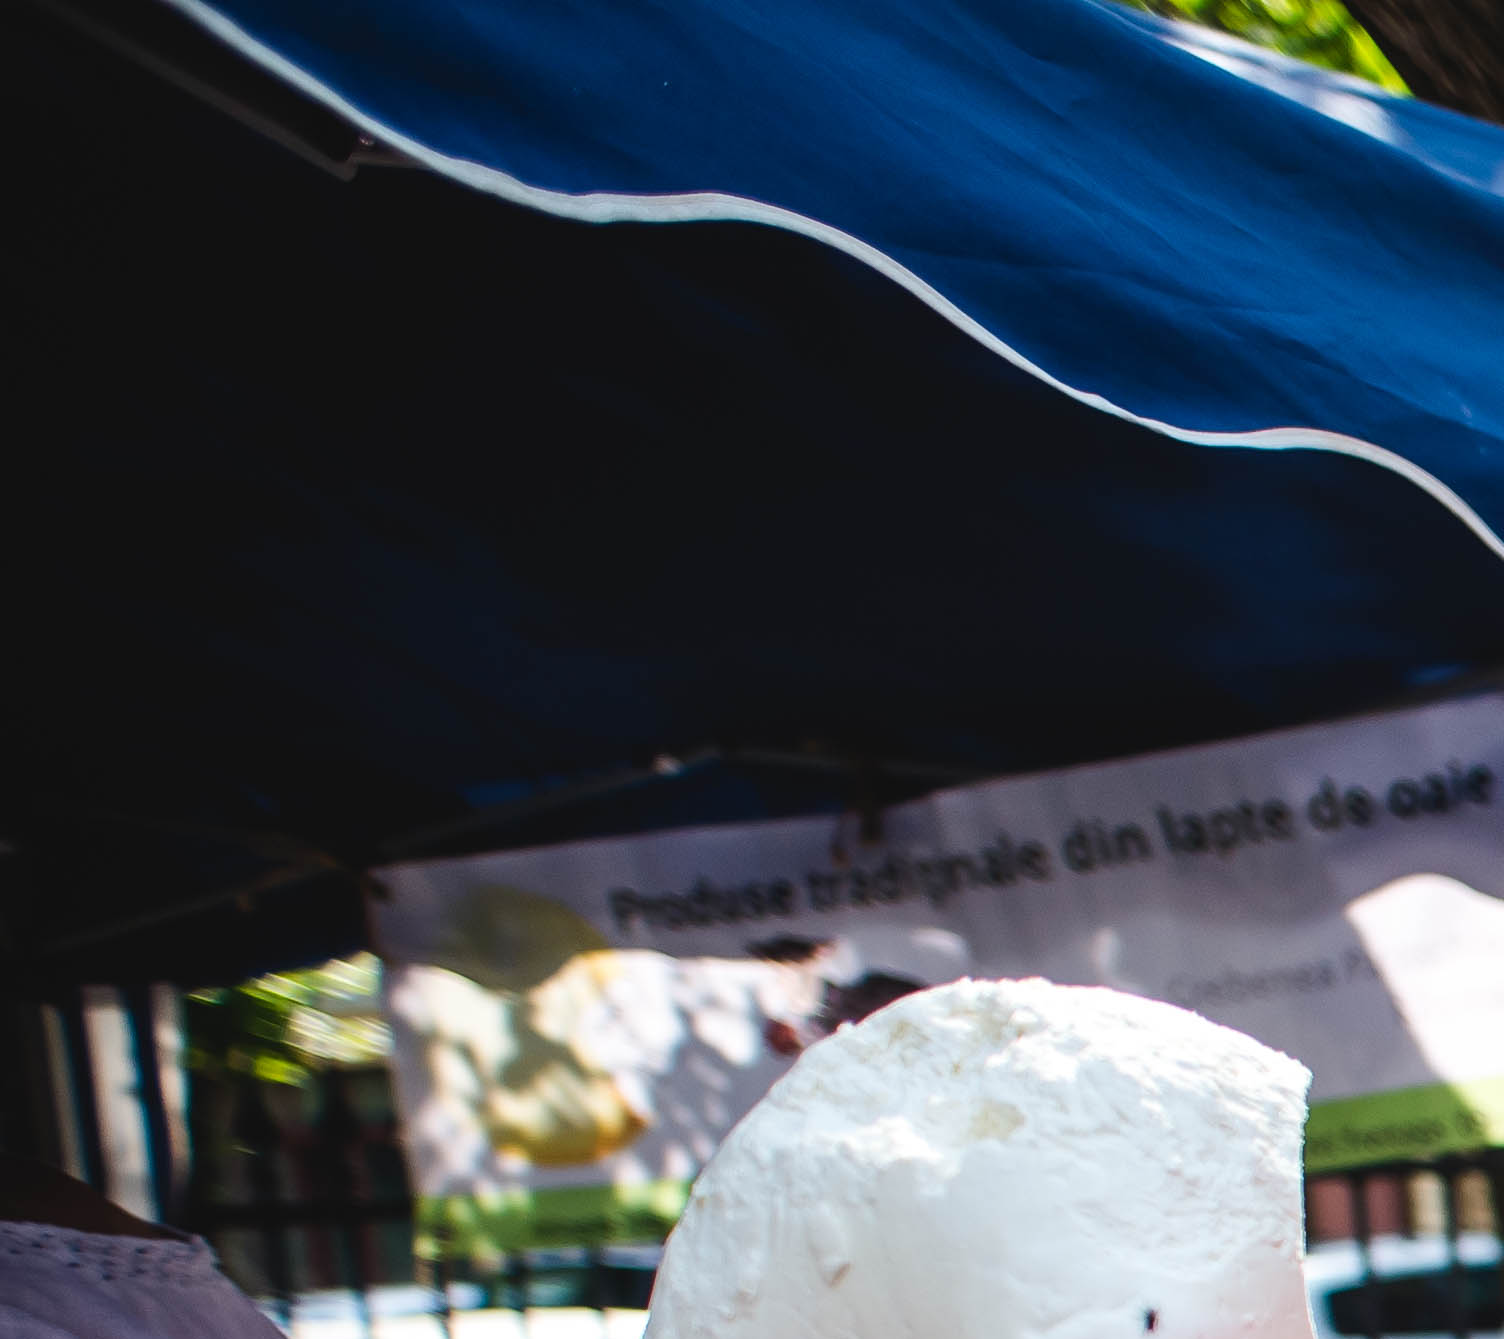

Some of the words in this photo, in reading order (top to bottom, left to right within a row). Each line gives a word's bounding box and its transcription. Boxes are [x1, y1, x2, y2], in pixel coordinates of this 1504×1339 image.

[1060, 813, 1152, 874] din
[1156, 796, 1294, 858] lapte
[1307, 776, 1376, 832] de
[1385, 759, 1494, 820] oaie
